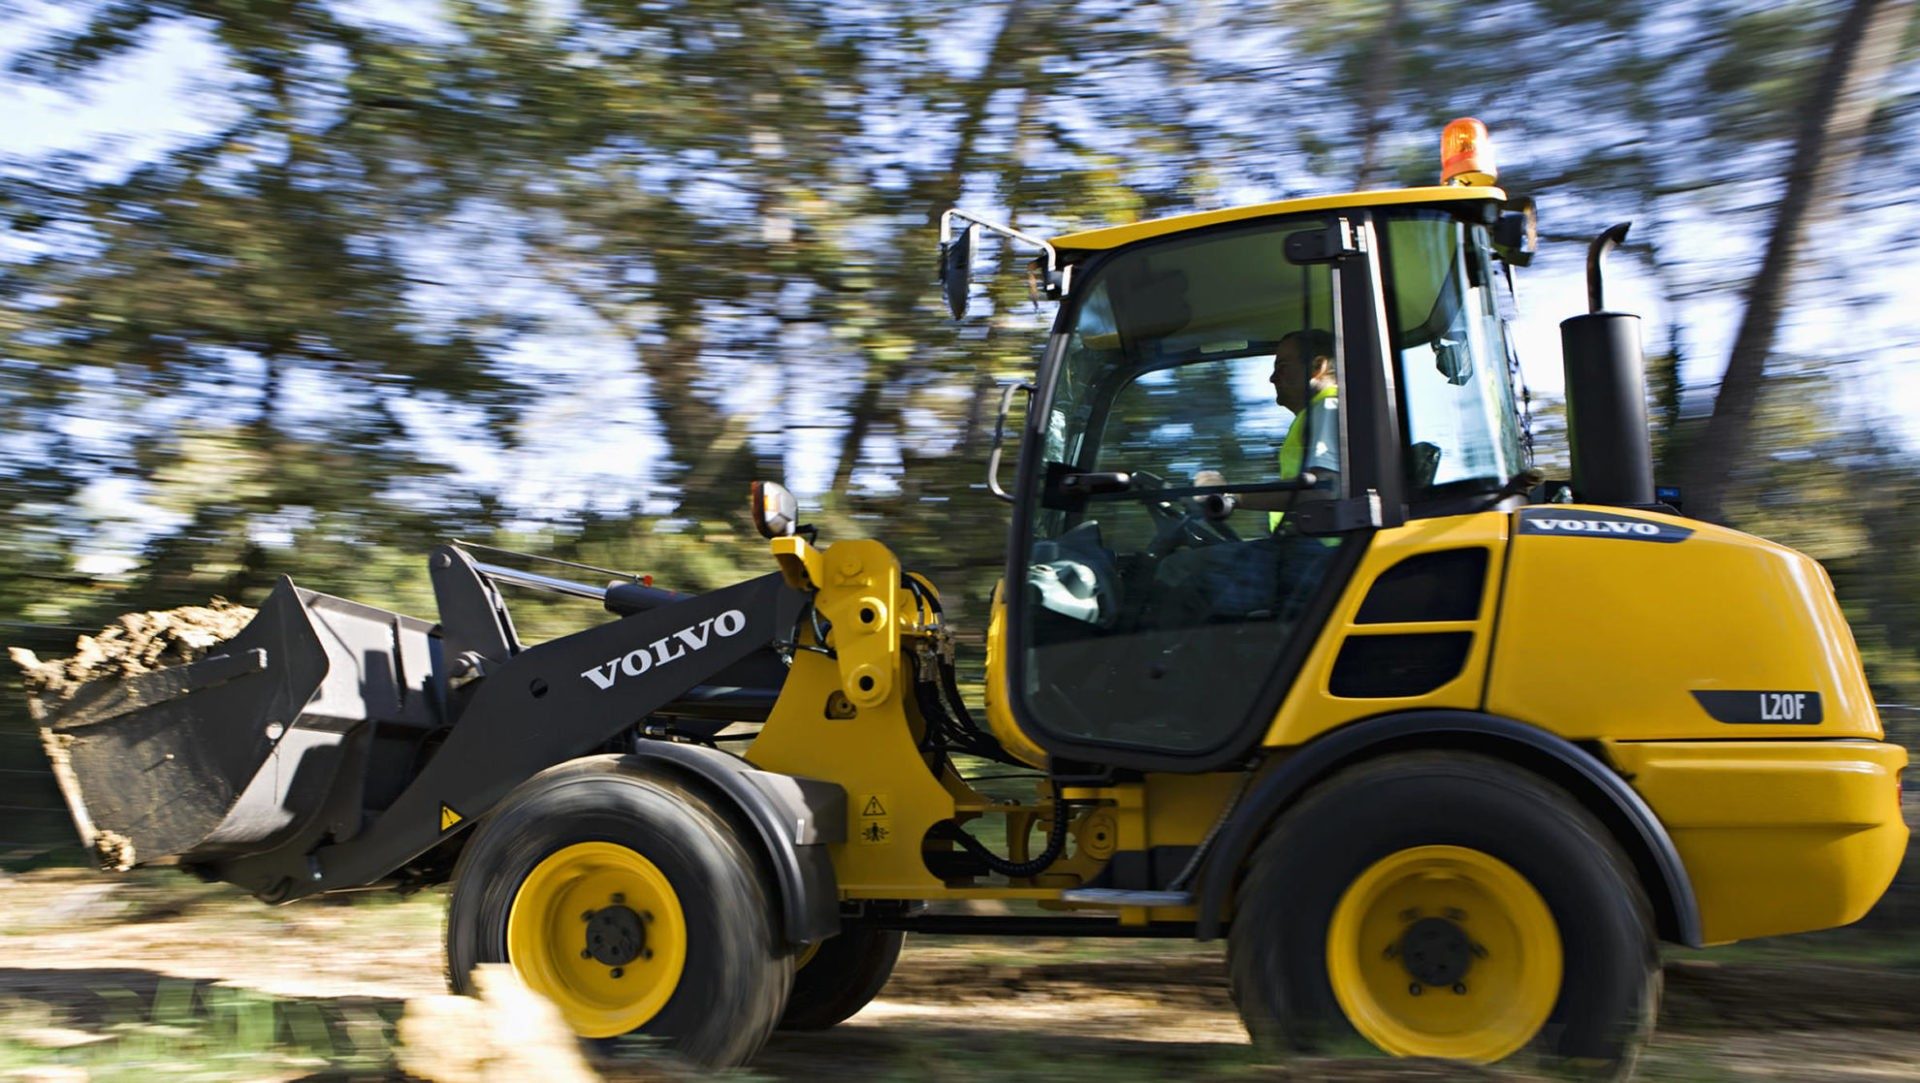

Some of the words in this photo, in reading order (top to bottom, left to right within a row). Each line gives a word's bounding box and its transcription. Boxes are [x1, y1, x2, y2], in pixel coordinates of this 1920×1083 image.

[1528, 518, 1661, 535] VOLVO
[580, 608, 746, 690] VOLVO
[1760, 693, 1805, 720] L20F
